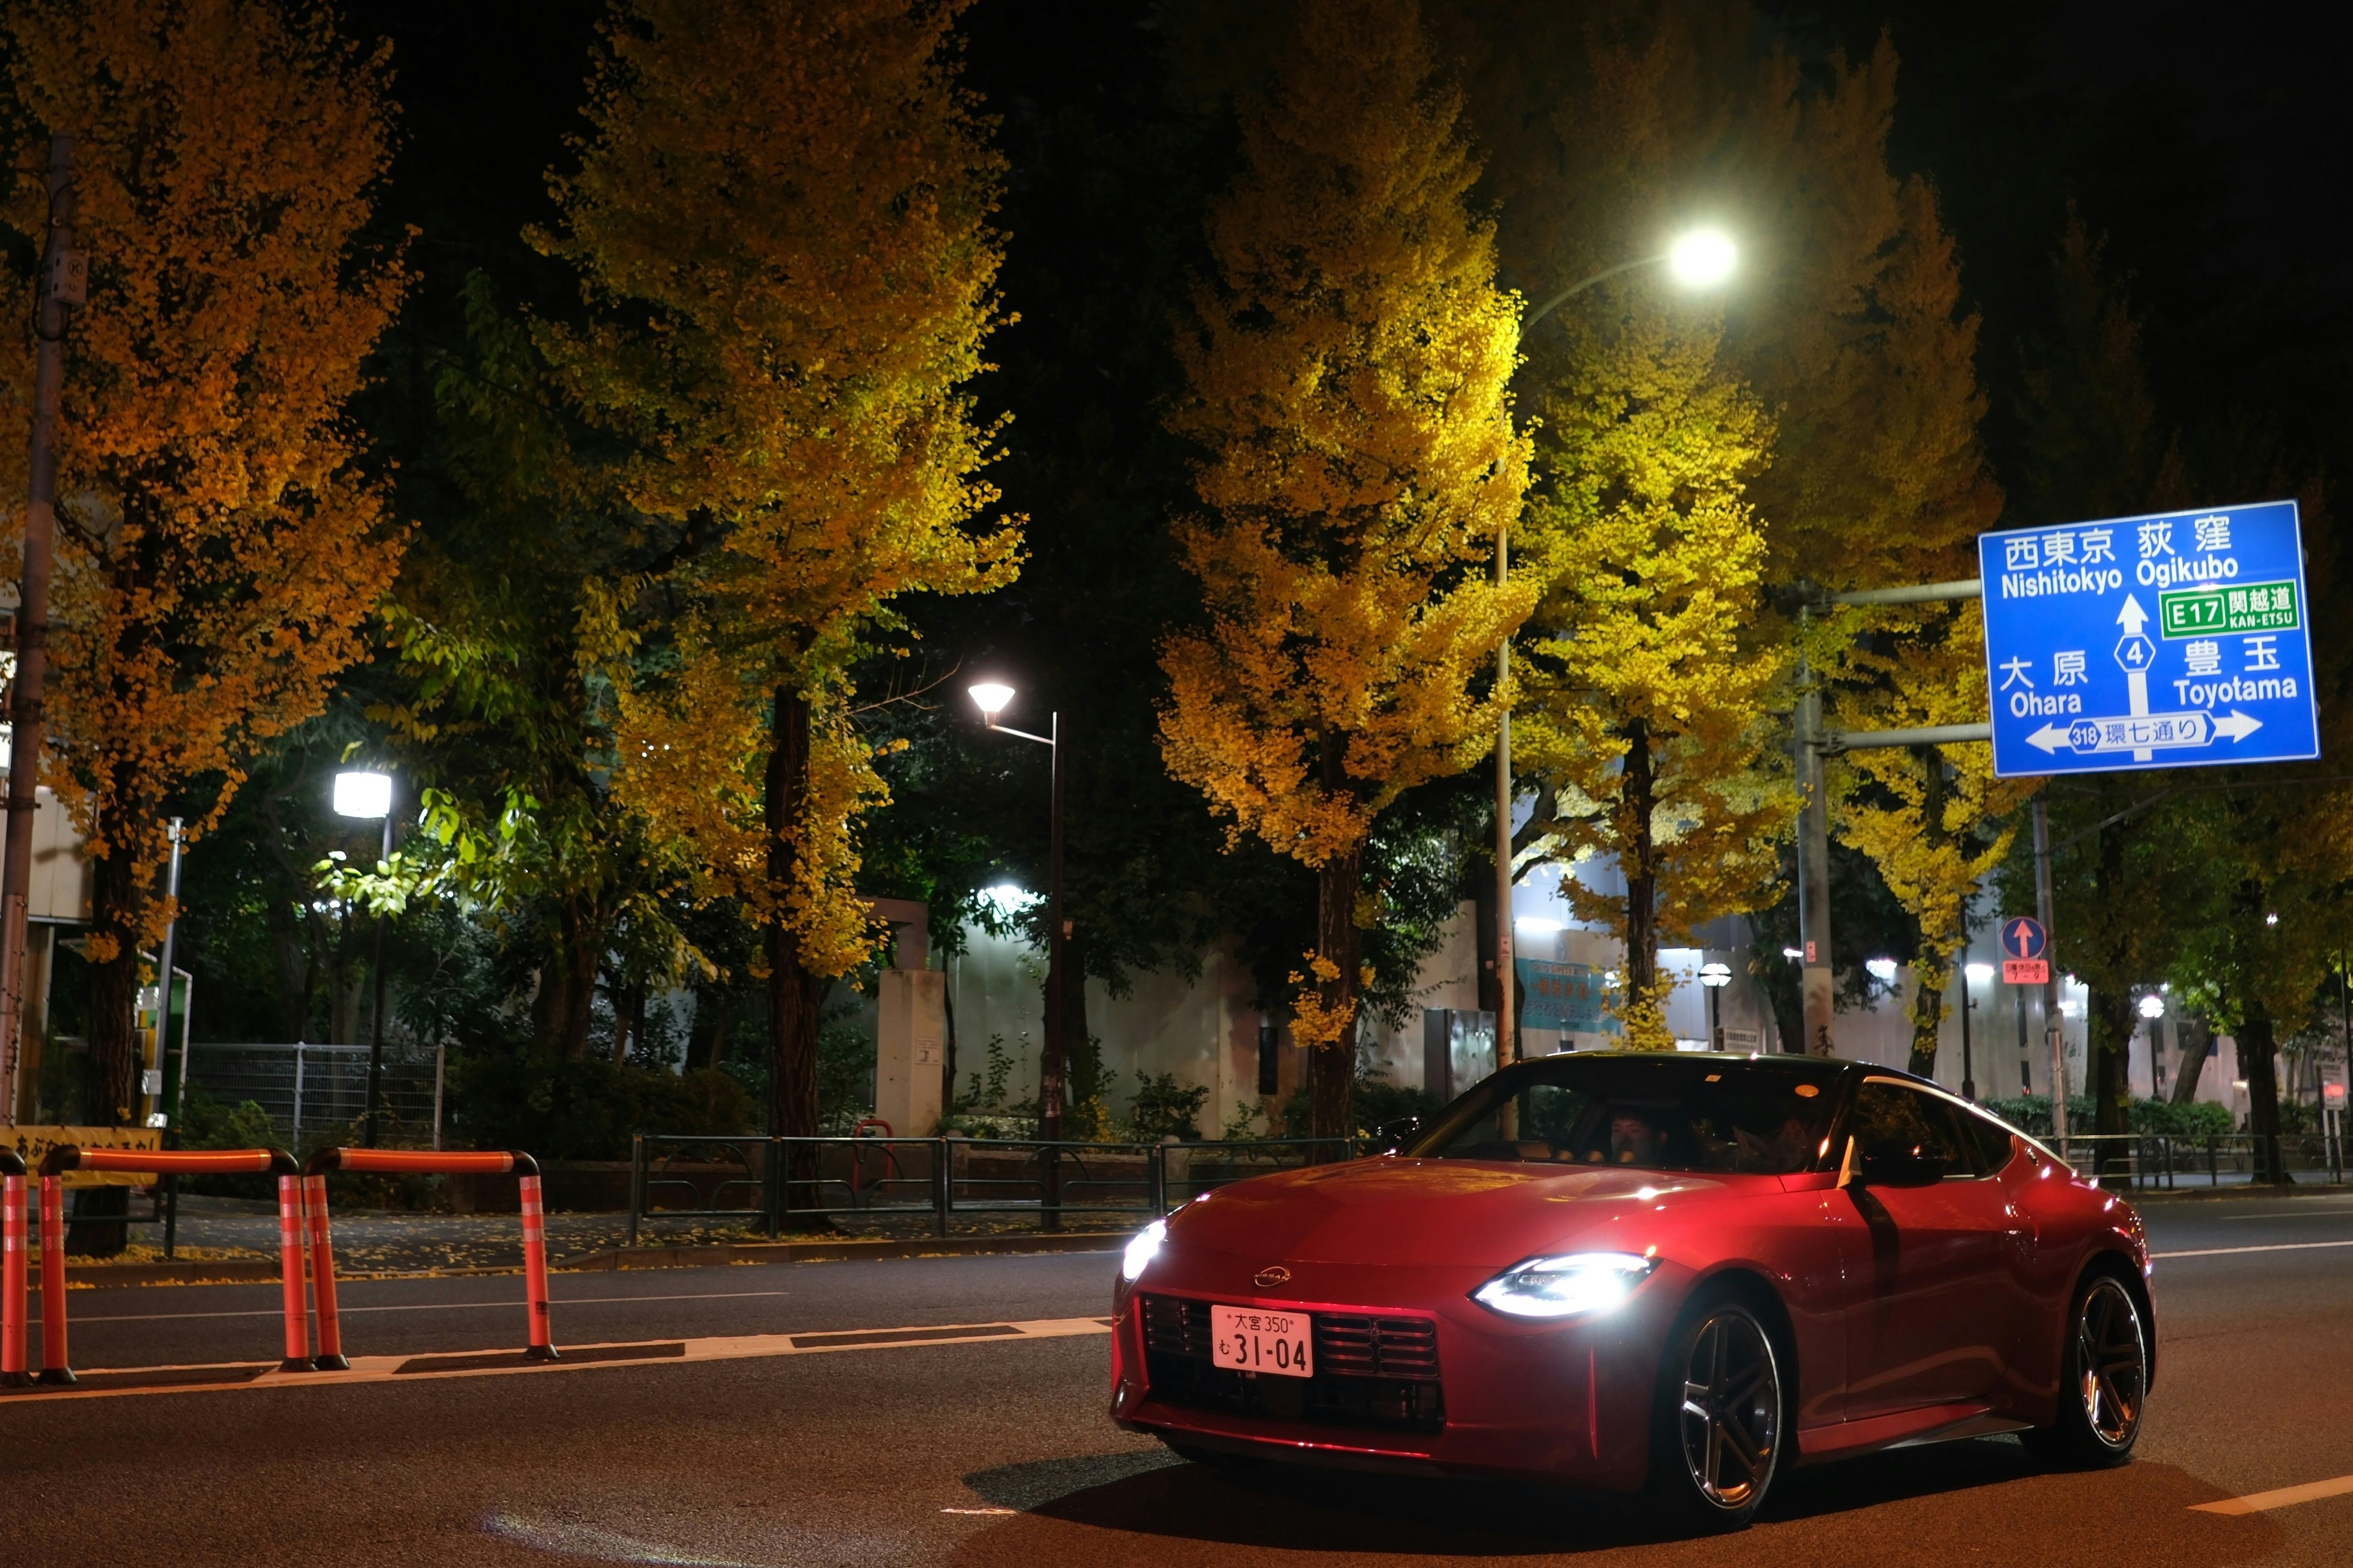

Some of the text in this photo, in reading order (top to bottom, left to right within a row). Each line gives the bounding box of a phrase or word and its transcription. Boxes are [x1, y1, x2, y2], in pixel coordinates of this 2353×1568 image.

[2005, 515, 2232, 571] 西東京 荻窪
[2002, 554, 2239, 599] Nishitokyo Ogikubo
[2172, 601, 2220, 625] E17
[2229, 587, 2292, 615] 関越道
[2229, 611, 2293, 629] KAN-ETSU
[2127, 641, 2143, 665] 4
[2184, 635, 2281, 677] 豊玉
[1999, 650, 2089, 691] 大原
[2010, 692, 2082, 718] Ohara
[2173, 676, 2298, 709] Toyotama
[2072, 726, 2098, 746] 318
[2105, 720, 2197, 745] 環七通り
[1253, 1273, 1292, 1282] NISSAN
[1235, 1313, 1289, 1333] 大宮 350
[1219, 1333, 1306, 1371] む 31-04
